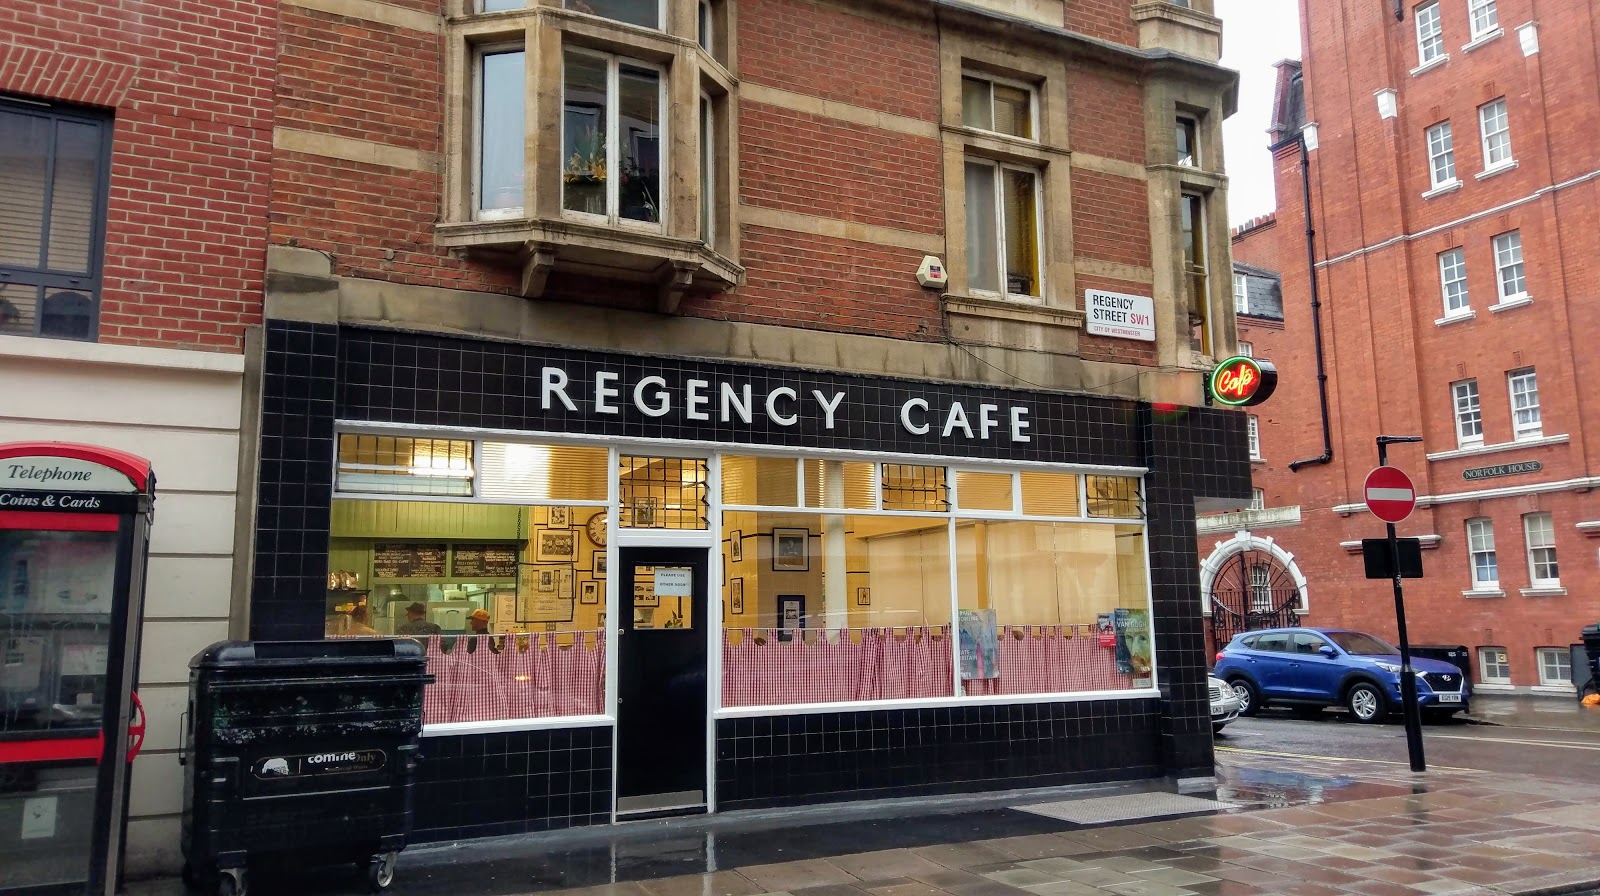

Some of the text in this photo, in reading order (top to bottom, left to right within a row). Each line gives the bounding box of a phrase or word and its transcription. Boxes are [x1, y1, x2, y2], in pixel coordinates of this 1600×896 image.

[1093, 294, 1134, 310] REGENCY
[1093, 308, 1149, 326] STREET SW1
[541, 367, 1031, 442] REGENCY CAFE
[8, 464, 92, 482] Telephone
[1465, 462, 1538, 479] NORFOLK HOUSE
[0, 493, 101, 508] Coins & Cards
